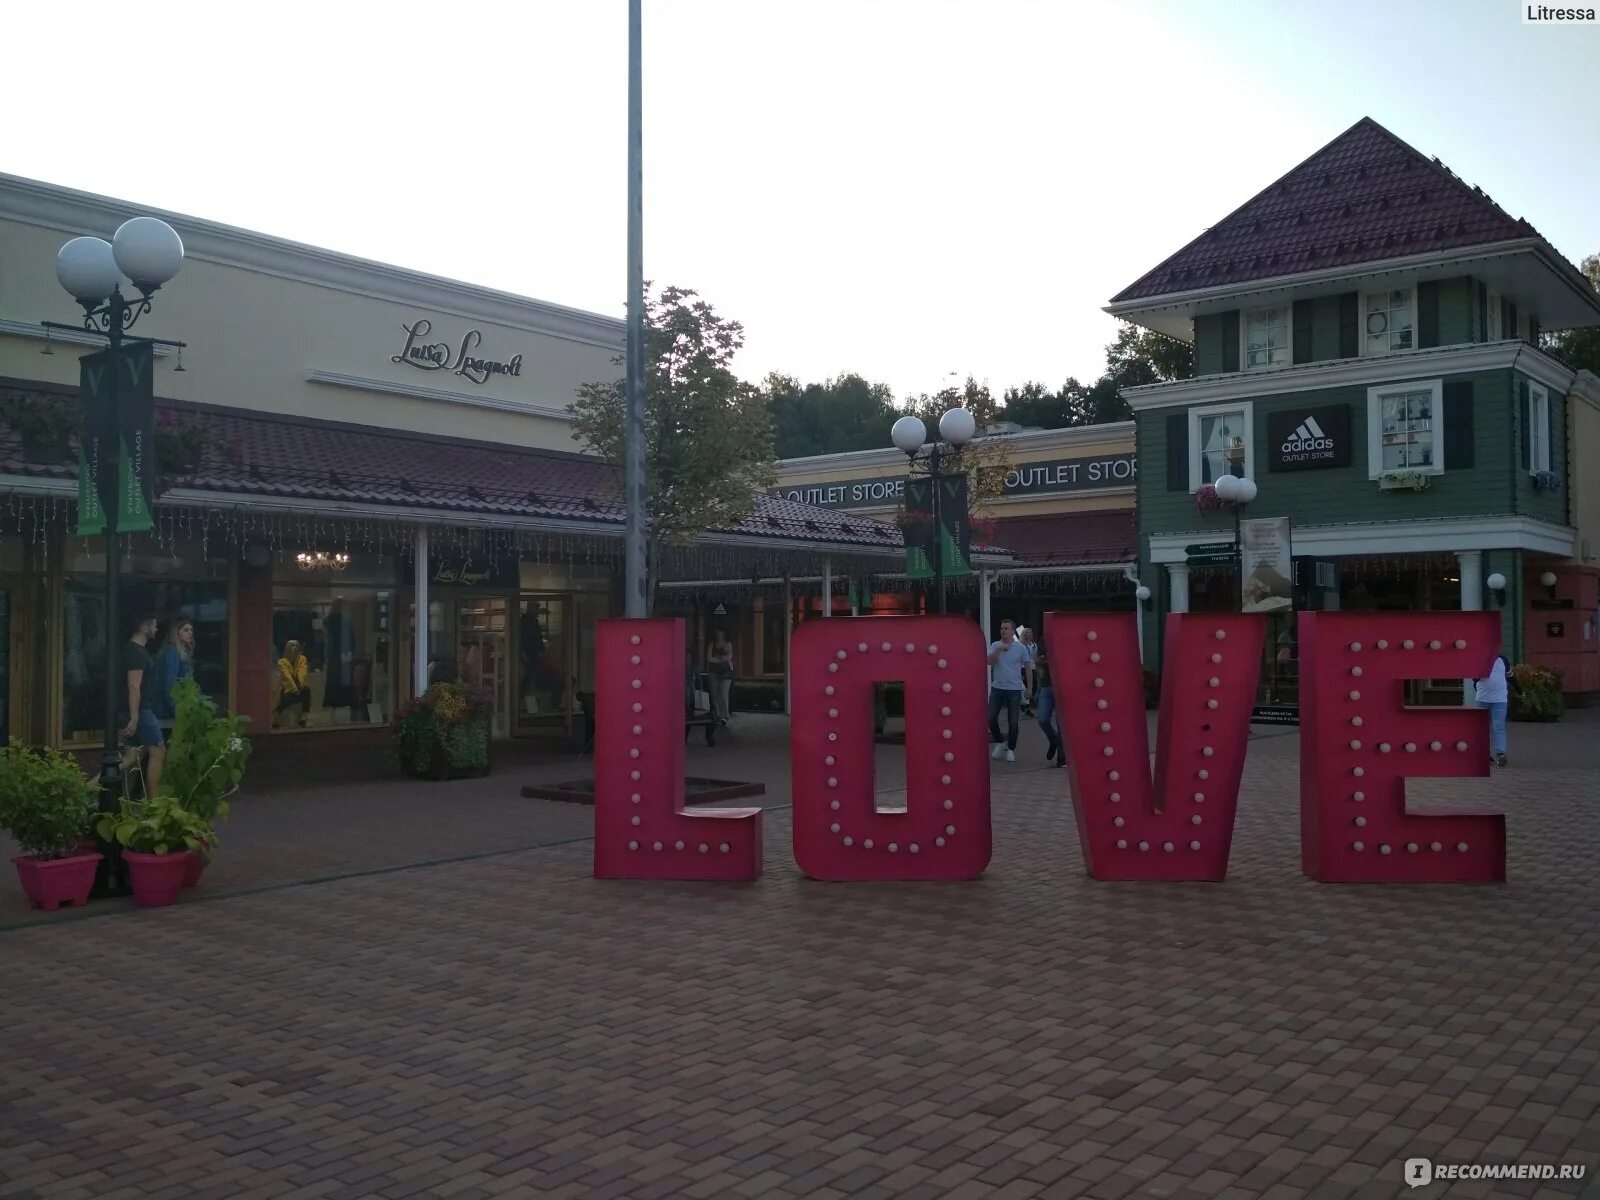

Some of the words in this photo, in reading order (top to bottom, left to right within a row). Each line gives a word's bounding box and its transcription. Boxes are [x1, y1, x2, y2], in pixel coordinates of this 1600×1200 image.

[391, 319, 450, 371] Luisa
[135, 428, 143, 473] VILLAGE
[1281, 438, 1335, 453] adidas
[1282, 453, 1310, 462] OUTLET
[1311, 451, 1335, 460] STORE
[1004, 464, 1081, 488] OUTLET
[135, 477, 143, 515] OUTLET
[787, 486, 848, 505] OUTLET
[594, 611, 1506, 883] LOVE
